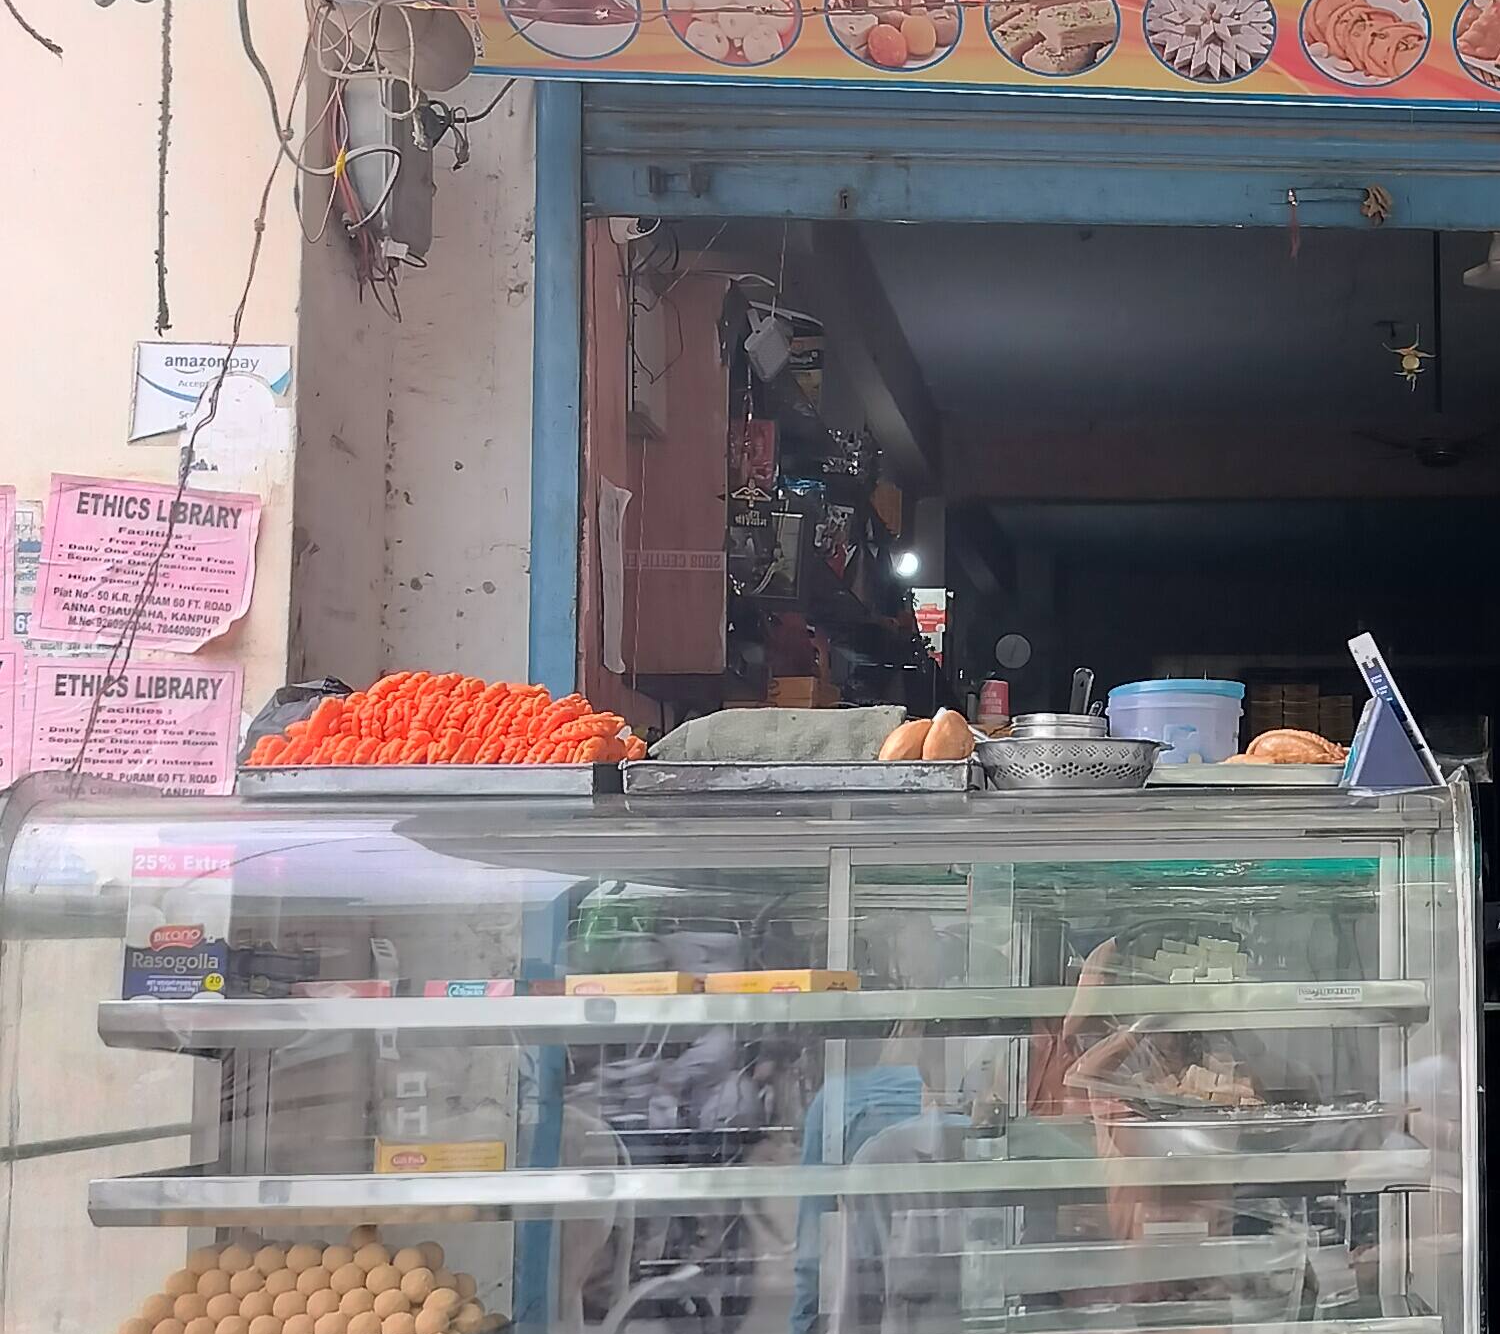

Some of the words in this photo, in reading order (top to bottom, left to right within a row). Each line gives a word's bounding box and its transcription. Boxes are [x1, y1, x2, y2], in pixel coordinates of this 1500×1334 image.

[165, 355, 227, 370] amazon
[229, 357, 259, 373] pay
[76, 492, 151, 521] ETHICS
[62, 603, 96, 614] ANNA
[171, 610, 220, 625] KANPUR
[54, 673, 129, 698] ETHICS
[135, 674, 223, 700] LIBRARY
[119, 773, 155, 784] PURAM
[189, 774, 218, 784] ROAD
[134, 854, 176, 871] 25%
[183, 855, 231, 871] Extra
[131, 952, 219, 974] Rasogolla
[208, 976, 222, 985] 20
